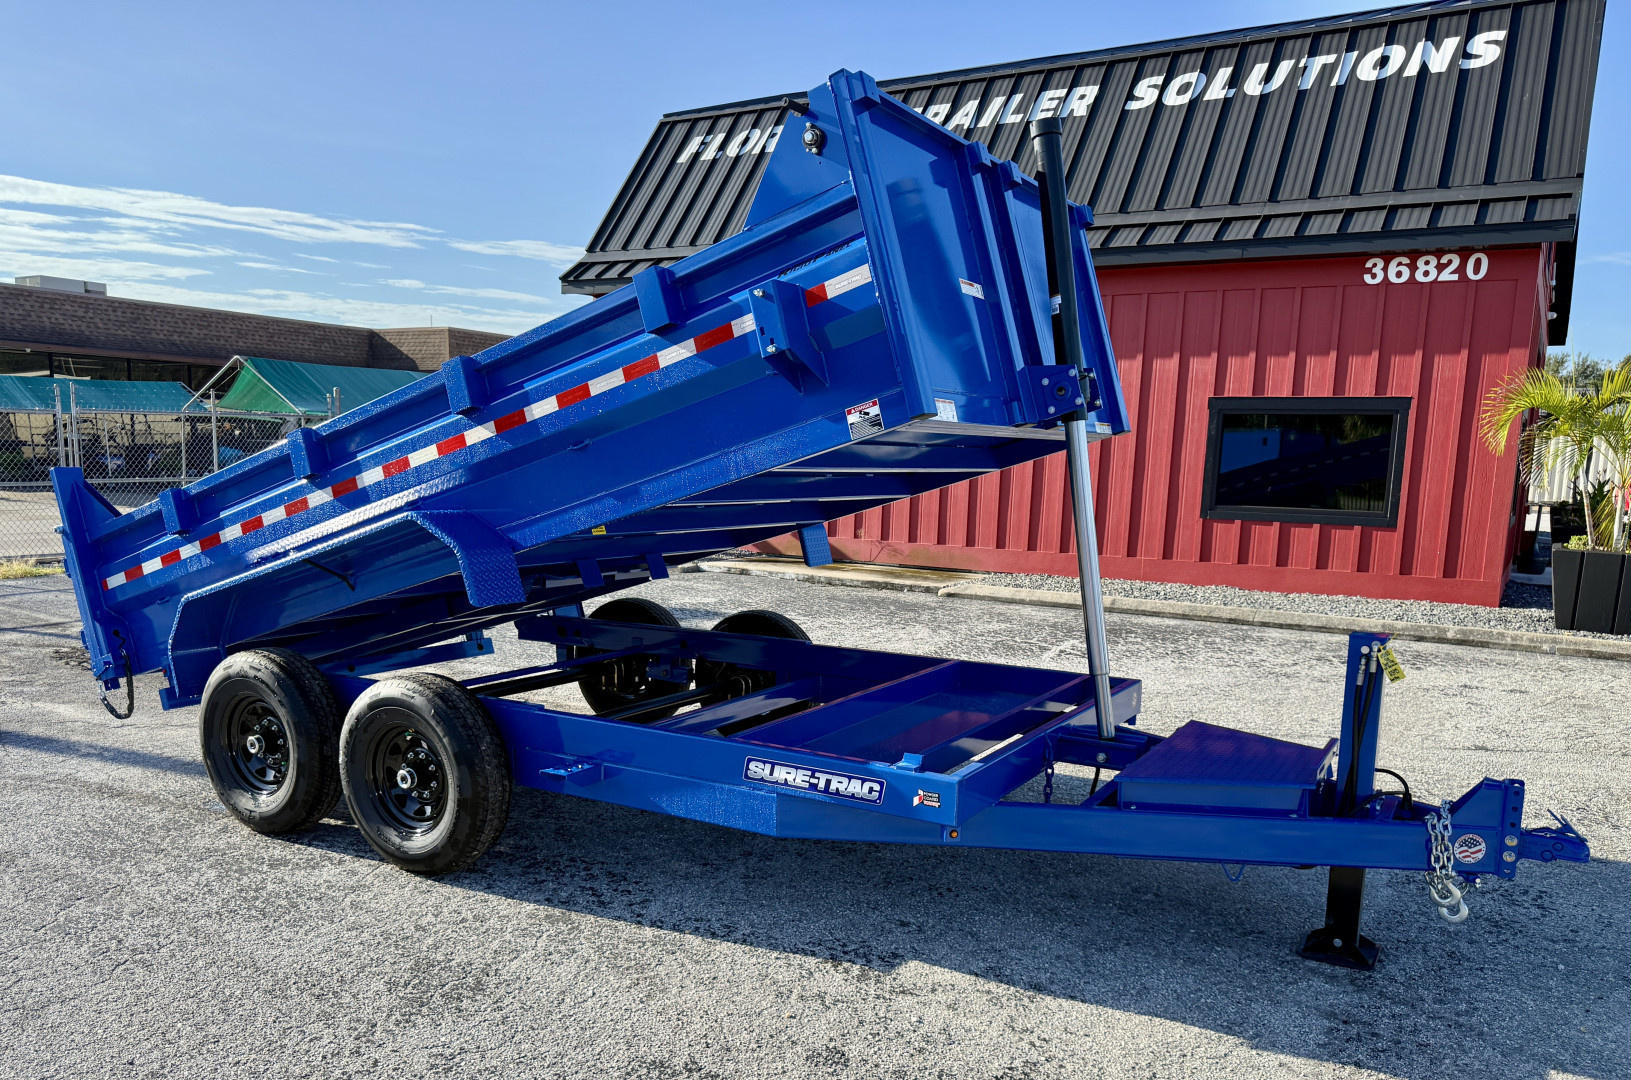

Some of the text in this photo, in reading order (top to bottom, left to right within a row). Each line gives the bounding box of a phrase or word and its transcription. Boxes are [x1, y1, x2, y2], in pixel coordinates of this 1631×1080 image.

[677, 30, 1507, 163] FLOR RAILER SOLUTIONS
[1363, 253, 1489, 285] 36820
[747, 761, 880, 800] SURE-TRAC
